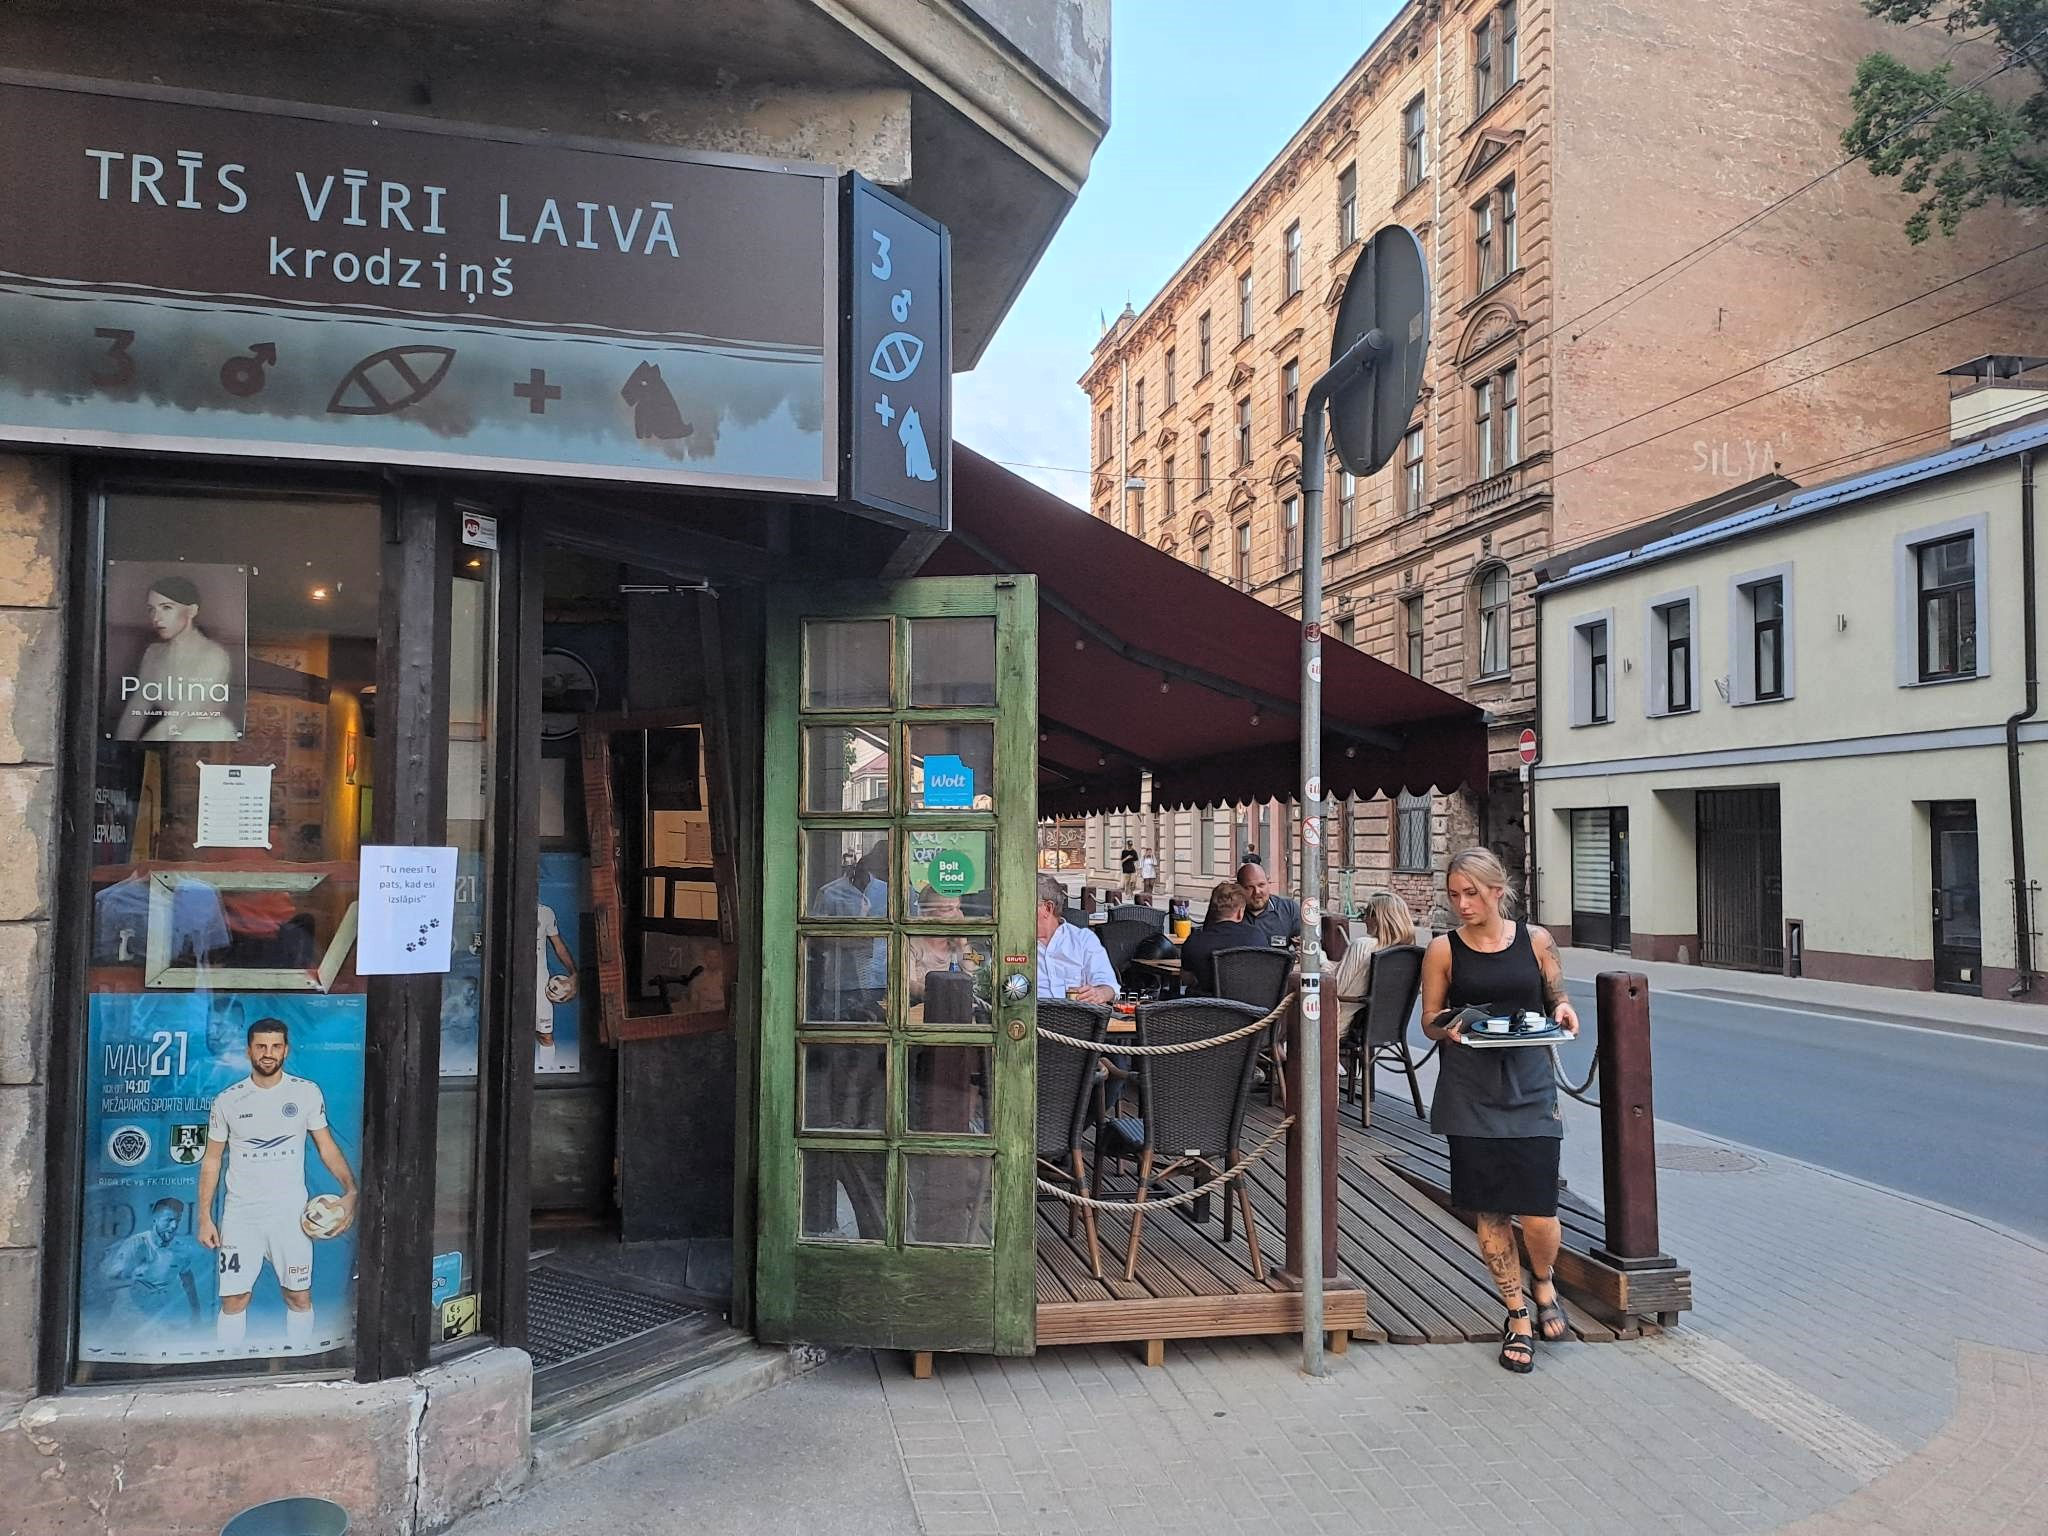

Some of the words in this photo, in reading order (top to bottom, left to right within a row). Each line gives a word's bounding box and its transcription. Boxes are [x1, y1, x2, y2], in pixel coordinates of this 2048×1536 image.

[85, 149, 248, 214] TRĪS
[295, 168, 447, 235] VĪRI
[499, 194, 680, 257] LAIVĀ
[872, 230, 892, 281] 3
[269, 236, 514, 303] krodziņš
[93, 327, 136, 387] 3
[121, 676, 229, 702] Palina
[931, 774, 966, 788] Wolt
[399, 866, 424, 874] neesi
[425, 865, 437, 874] Tu
[939, 861, 959, 870] Bolt
[379, 881, 402, 890] pats,
[405, 880, 421, 889] kad
[423, 880, 435, 889] esi
[939, 872, 964, 881] Food
[456, 876, 476, 902] 21
[104, 1044, 150, 1077] MAY
[151, 1031, 188, 1076] 21
[125, 1080, 150, 1094] 14:00
[102, 1097, 149, 1113] MEŽAPARKS
[151, 1098, 183, 1112] SPORTS
[147, 1177, 159, 1186] FK
[219, 1252, 241, 1274] 34
